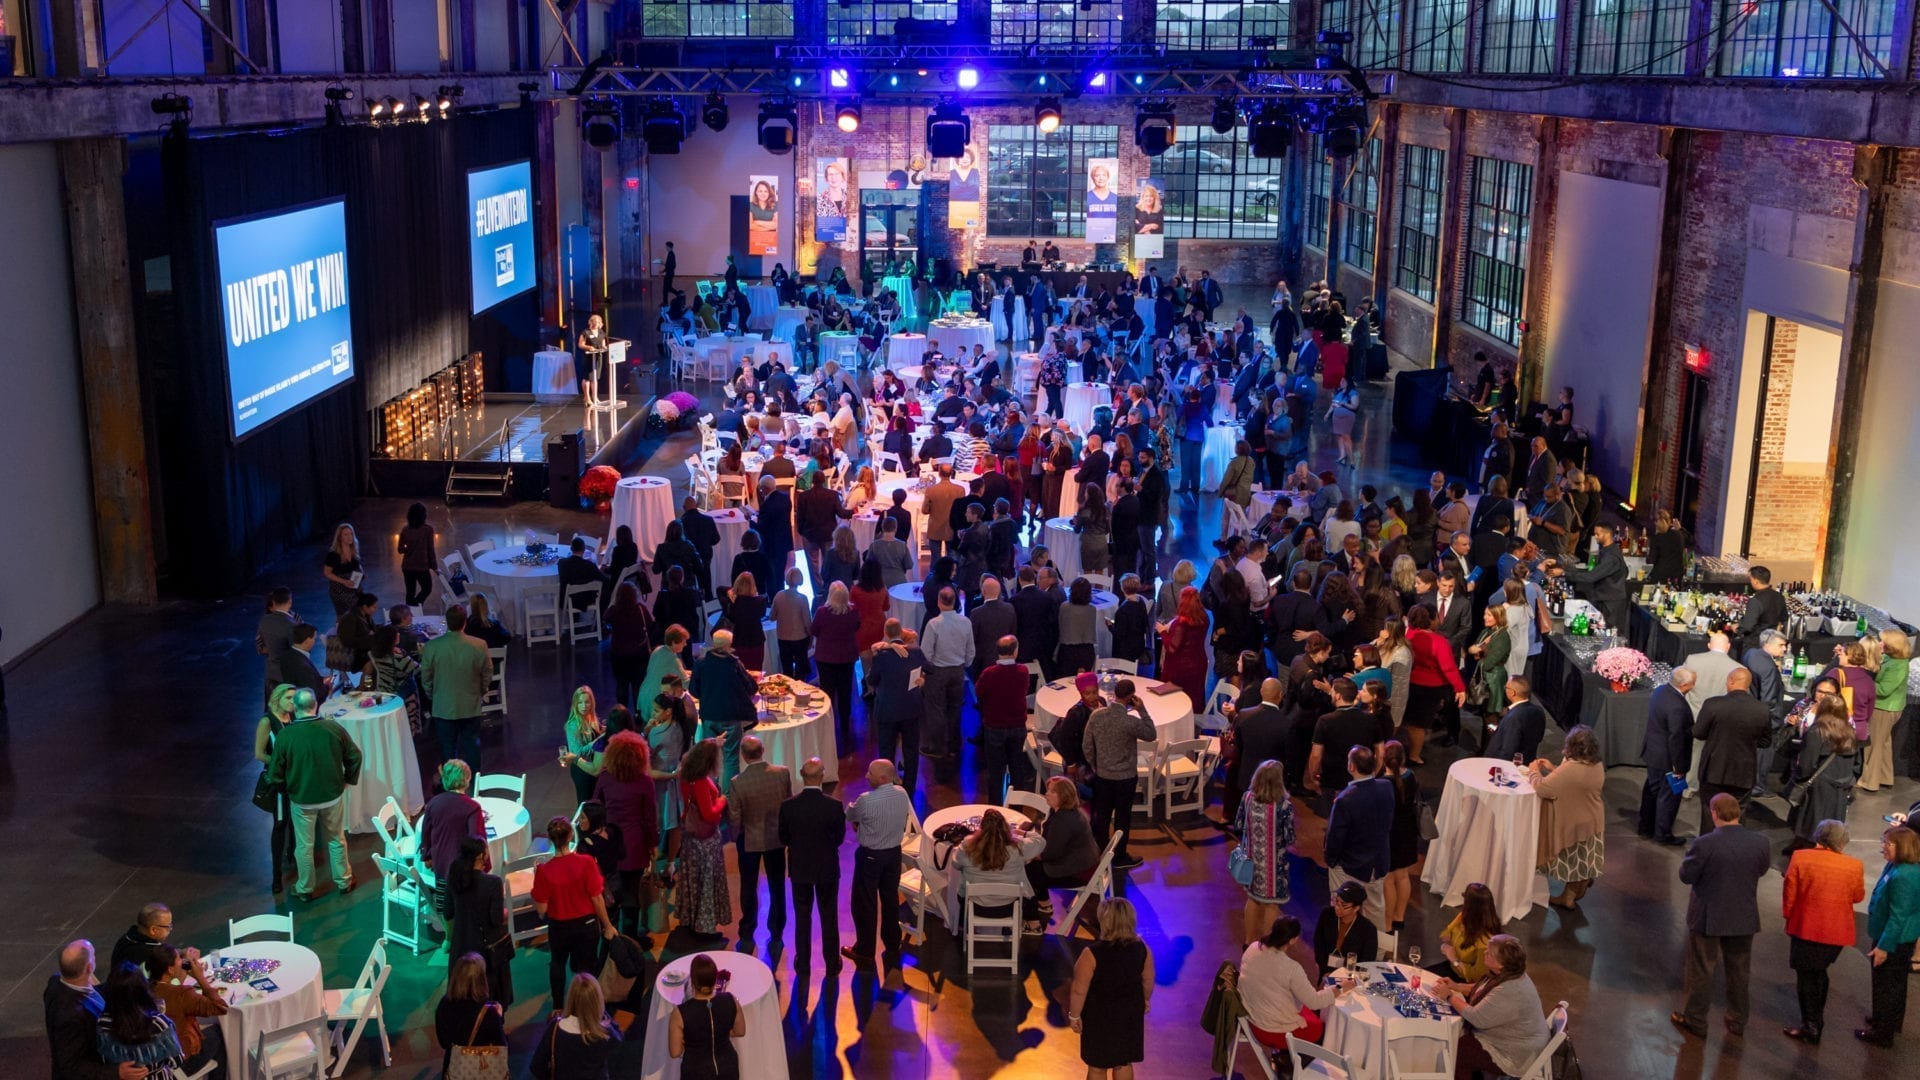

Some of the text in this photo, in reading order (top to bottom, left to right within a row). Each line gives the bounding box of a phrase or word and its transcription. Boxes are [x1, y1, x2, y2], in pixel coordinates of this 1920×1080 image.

[227, 251, 346, 347] UNITED WE WIN
